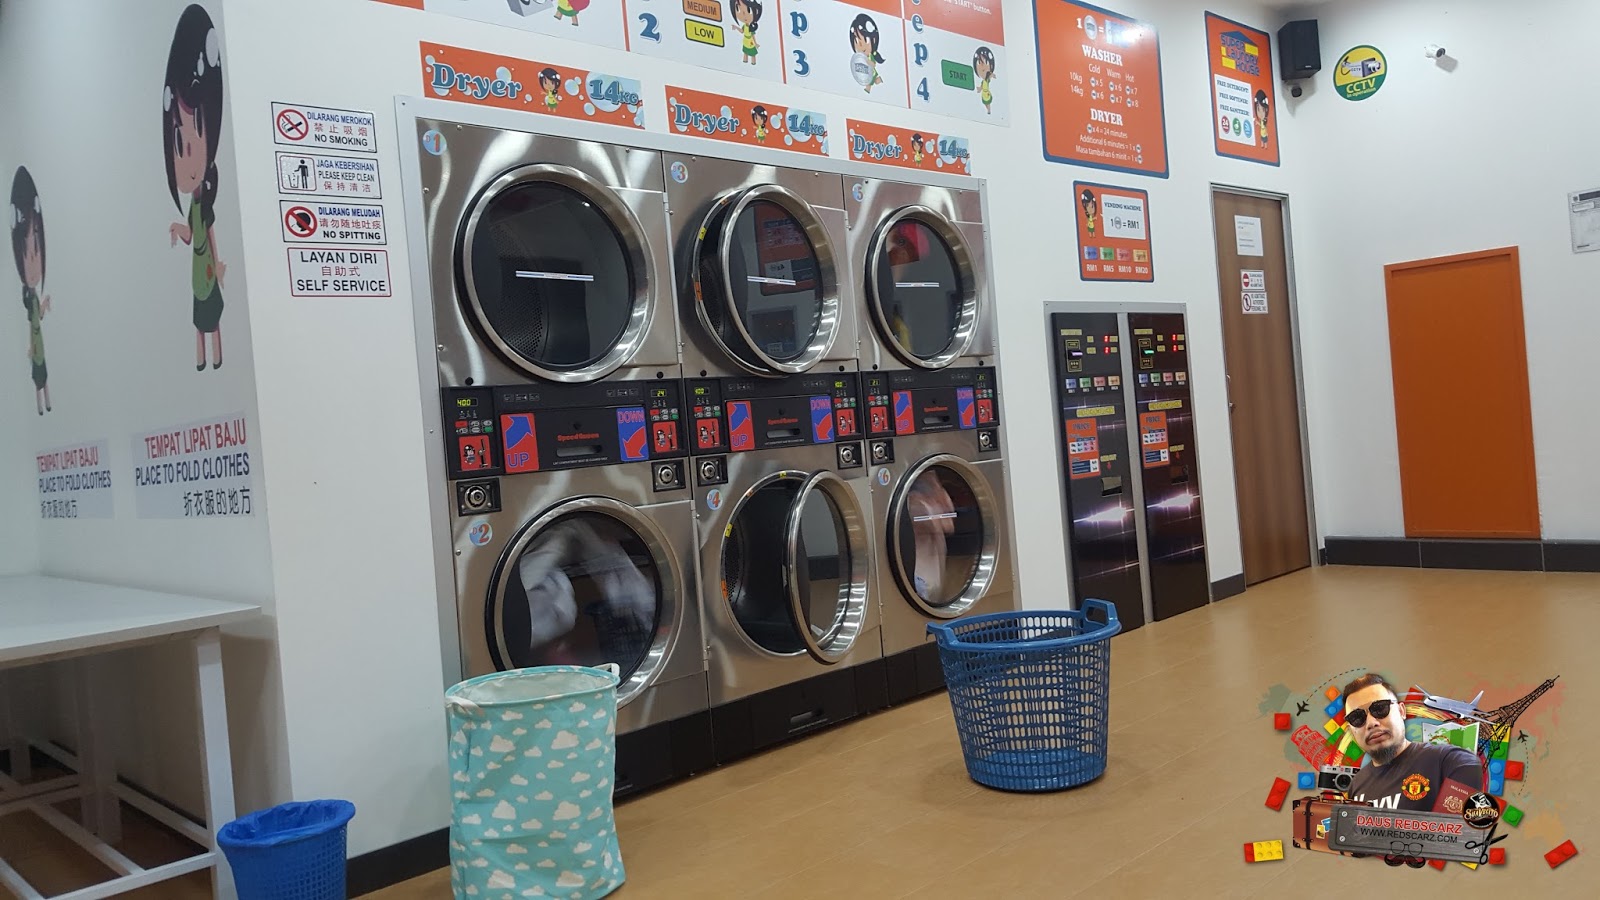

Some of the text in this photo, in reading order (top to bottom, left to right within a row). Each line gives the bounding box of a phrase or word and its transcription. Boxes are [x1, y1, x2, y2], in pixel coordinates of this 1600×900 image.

[687, 1, 717, 16] MEDIUM
[638, 13, 660, 43] 2
[694, 27, 715, 39] LOW
[1082, 44, 1123, 66] WASHER
[794, 50, 809, 76] 3
[949, 70, 967, 81] START
[1070, 72, 1082, 84] 10kg
[1088, 63, 1134, 82] Cold Warm Hot
[432, 63, 522, 100] Dryer
[1216, 80, 1226, 88] FREE
[1346, 78, 1376, 94] CCTV
[916, 79, 930, 102] 4
[1070, 84, 1084, 96] 14kg
[1219, 92, 1229, 100] FREE
[307, 112, 372, 126] DILARANG MEROKOK
[674, 103, 740, 134] Dryer
[1090, 108, 1124, 126] DRYER
[313, 122, 368, 137] 禁止吸烟
[1110, 129, 1128, 138] minutes
[314, 134, 368, 146] NO SMOKING
[853, 134, 903, 159] Dryer
[1080, 134, 1103, 146] Additional
[1107, 140, 1125, 149] minutes
[1076, 145, 1088, 154] Masa
[1088, 148, 1111, 158] tambahan
[316, 160, 374, 172] JAGA KEBERSIHAN
[318, 170, 375, 182] PLEASE KEEP CLEAN
[324, 181, 371, 193] 保持清洁
[318, 206, 381, 218] DILARANG MELUDAH
[319, 218, 382, 230] 请勿随地吐痰
[1127, 220, 1139, 229] RM1
[323, 230, 381, 240] NO SPITTING
[300, 252, 377, 264] LAYAN DIRI
[321, 266, 360, 277] 自助式
[296, 279, 386, 292] SELF SERVICE
[958, 390, 974, 400] DOWN
[811, 400, 831, 411] DOWN
[617, 411, 645, 424] DOWN
[897, 420, 910, 431] UP
[145, 418, 246, 459] TEMPAT LIPAT BAJU
[557, 434, 578, 442] Speed
[732, 435, 748, 447] UP
[36, 446, 98, 473] TEMPAT LIPAT BAJU
[506, 452, 530, 468] UP
[136, 452, 249, 486] PLACE TO FOLD CLOTHES
[39, 470, 111, 493] PLACE TO FOLD CLOTHES
[184, 485, 251, 516] 折衣服的地方
